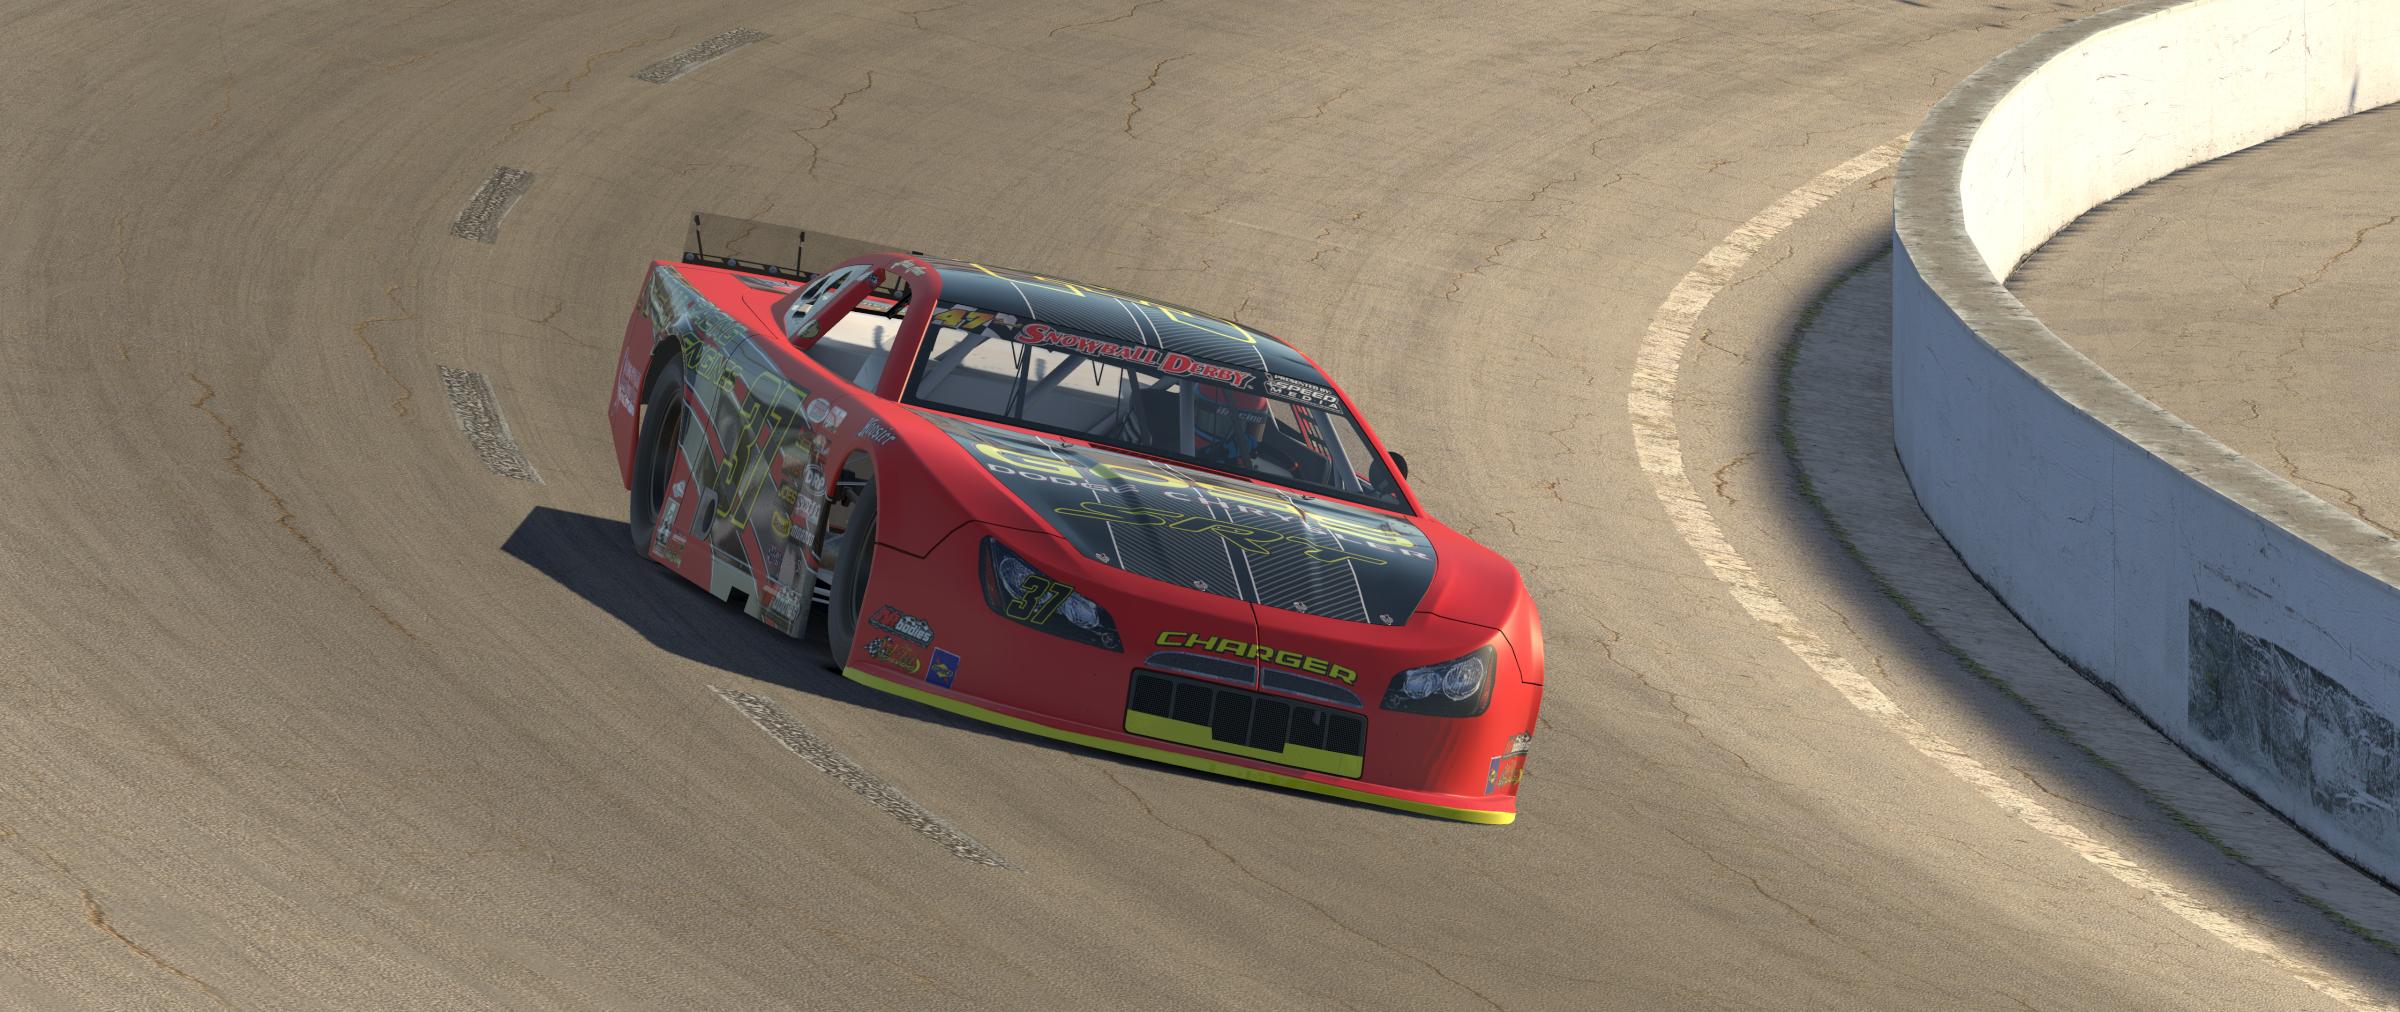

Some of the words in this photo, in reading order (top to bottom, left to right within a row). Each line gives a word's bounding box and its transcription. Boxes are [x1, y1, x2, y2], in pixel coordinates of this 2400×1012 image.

[1015, 322, 1158, 366] SNOWBALL
[1160, 351, 1253, 389] DERBY
[1269, 386, 1339, 410] MEDIA
[1273, 381, 1338, 403] SPEED
[987, 463, 1139, 494] DODGE
[1163, 490, 1433, 561] CHRYSLER
[1053, 500, 1388, 564] SRT
[1006, 575, 1074, 625] 37
[895, 618, 932, 642] bodies
[1155, 631, 1358, 685] CHARGER
